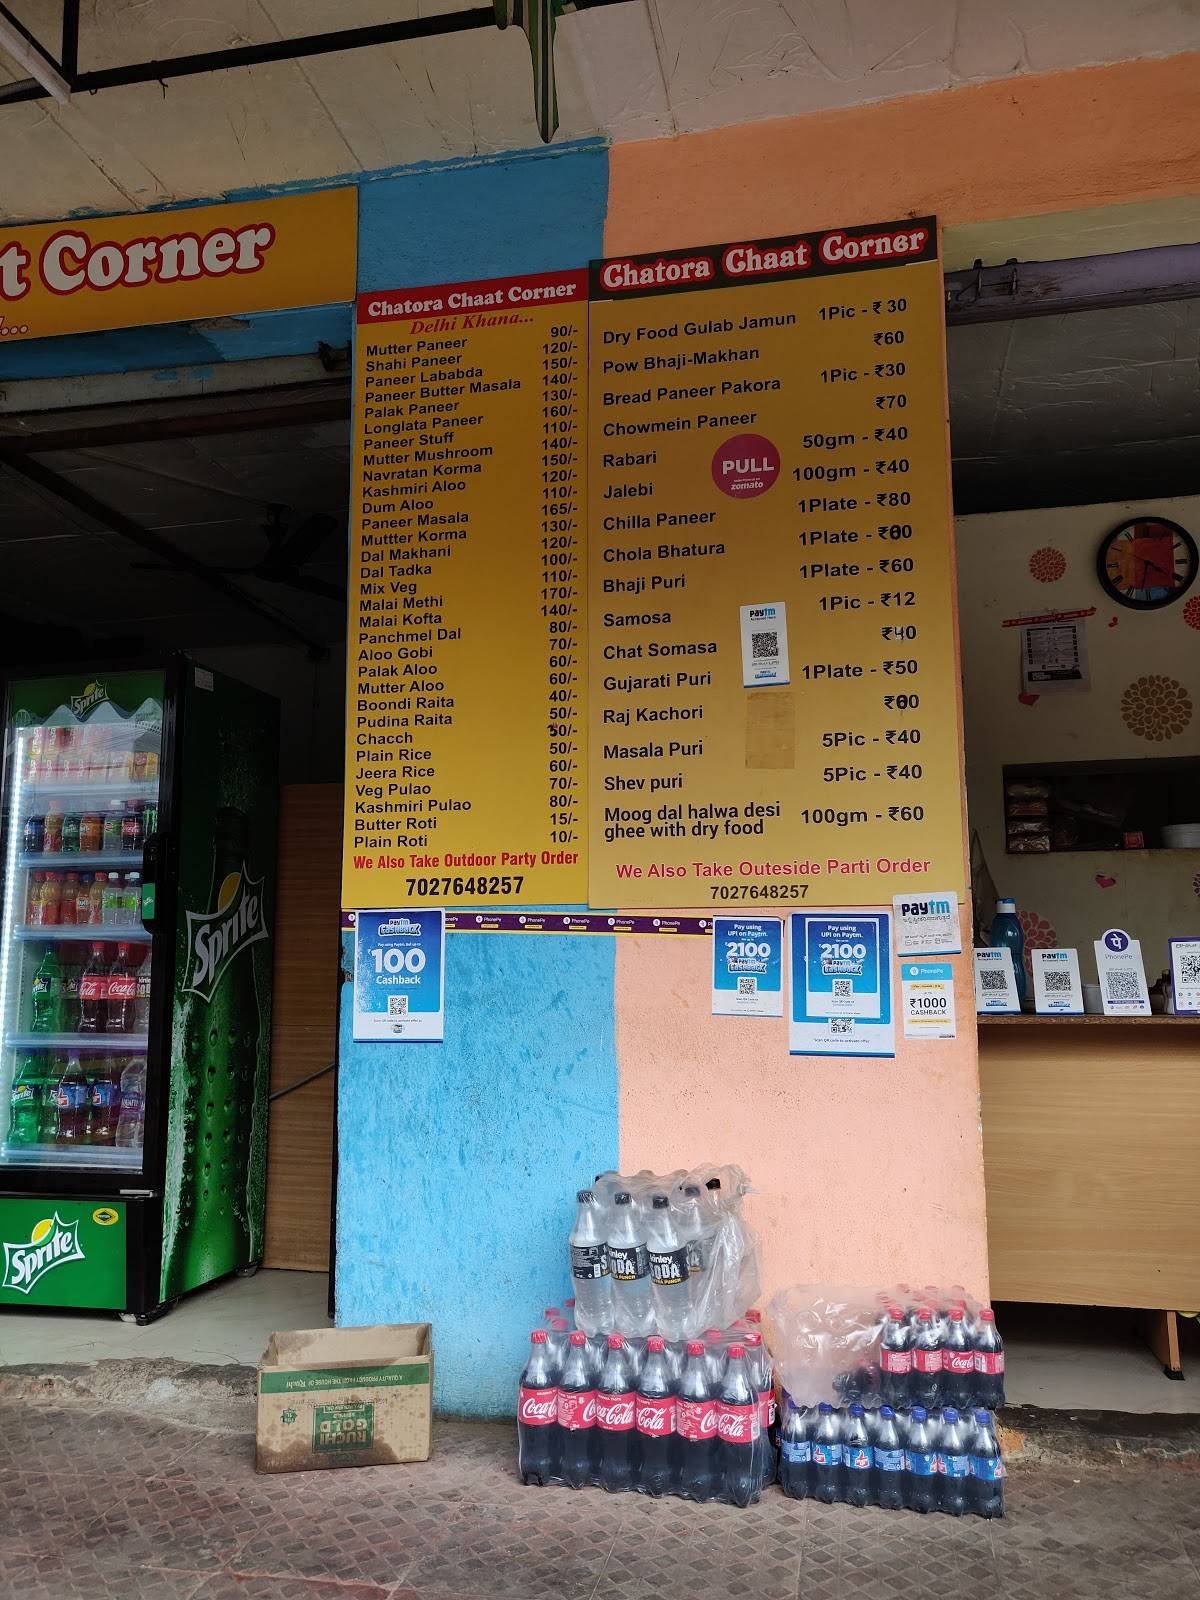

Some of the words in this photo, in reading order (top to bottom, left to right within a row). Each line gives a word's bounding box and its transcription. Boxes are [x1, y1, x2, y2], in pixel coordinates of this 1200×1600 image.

[41, 225, 273, 293] Corner
[603, 259, 710, 288] Chatora
[725, 245, 808, 273] Chaat
[823, 231, 925, 260] Corner
[368, 299, 443, 317] Chatora
[447, 290, 503, 309] Chaat
[507, 283, 577, 302] Corner
[818, 305, 856, 321] 1Pic
[872, 300, 882, 314] ₹
[886, 298, 907, 313] 30
[409, 317, 458, 334] Delhi
[461, 312, 534, 330] Khana...
[550, 324, 578, 338] 90/-
[603, 330, 631, 346] Dry
[636, 323, 678, 341] Food
[683, 318, 734, 336] Gulab
[738, 314, 796, 330] Jamun
[873, 330, 905, 346] ₹60
[366, 343, 413, 357] Mutter
[416, 338, 468, 352] Paneer
[541, 355, 578, 370] 150/-
[603, 360, 639, 374] Pow
[644, 348, 759, 370] Bhaji-Makhan
[365, 375, 416, 388] Paneer
[420, 366, 483, 383] Lababda
[542, 387, 578, 402] 130/-
[364, 405, 404, 419] Palak
[408, 401, 460, 415] Paneer
[542, 419, 578, 434] 110/-
[363, 437, 415, 450] Paneer
[418, 431, 455, 446] Stuff
[802, 433, 854, 450] 50gm
[873, 426, 908, 442] ₹40
[541, 452, 578, 467] 150/-
[603, 450, 657, 468] Rabari
[722, 457, 775, 475] PULL
[362, 467, 428, 482] Navratan
[432, 463, 482, 476] Korma
[792, 465, 856, 482] 100gm
[875, 458, 910, 475] ₹40
[542, 484, 578, 500] 110/-
[603, 481, 653, 499] Jalebi
[730, 481, 764, 490] zomato
[362, 502, 396, 514] Dum
[399, 498, 434, 511] Aloo
[797, 497, 858, 513] 1Plate
[876, 491, 911, 507] ₹80
[541, 518, 578, 533] 130/-
[603, 514, 651, 531] Chilla
[656, 511, 717, 527] Paneer
[361, 533, 414, 546] Muttter
[418, 529, 467, 542] Korma
[541, 552, 578, 566] 100/-
[360, 565, 384, 579] Dal
[387, 563, 432, 577] Tadka
[540, 585, 578, 600] 170/-
[818, 595, 861, 611] 1Pic
[880, 591, 916, 607] ₹12
[359, 598, 398, 612] Malai
[402, 595, 443, 609] Methi
[549, 619, 578, 634] 80/-
[603, 612, 671, 627] Samosa
[358, 628, 432, 644] Panchmel
[437, 627, 461, 641] Dal
[549, 654, 578, 668] 60/-
[802, 663, 863, 680] 1Plate
[882, 659, 918, 675] ₹50
[358, 664, 399, 678] Palak
[402, 663, 437, 676] Aloo
[603, 672, 670, 693] Gujarati
[676, 671, 711, 687] Puri
[74, 686, 104, 715] Sprite
[548, 688, 578, 702] 40/-
[357, 697, 411, 712] Boondi
[416, 696, 454, 709] Raita
[822, 731, 866, 747] 5Pic
[884, 728, 921, 745] ₹40
[356, 749, 393, 762] Plain
[398, 747, 432, 761] Rice
[549, 740, 578, 755] 50/-
[603, 741, 664, 759] Masala
[669, 739, 703, 757] Puri
[355, 784, 383, 799] Veg
[388, 782, 431, 796] Pulao
[549, 776, 578, 790] 70/-
[550, 811, 578, 825] 15/-
[604, 807, 652, 824] Moog
[657, 803, 682, 820] dal
[688, 803, 739, 819] halwa
[743, 801, 780, 818] desi
[801, 808, 868, 827] 100gm
[887, 805, 924, 821] ₹60
[354, 818, 402, 831] Butter
[406, 816, 437, 830] Roti
[604, 822, 645, 843] ghee
[650, 820, 686, 838] with
[691, 820, 719, 840] dry
[723, 818, 764, 835] food
[354, 835, 392, 848] Plain
[397, 834, 428, 847] Roti
[549, 829, 578, 843] 10/-
[353, 855, 373, 869] We
[377, 854, 405, 869] Also
[409, 854, 440, 868] Take
[444, 853, 497, 867] Outdoor
[501, 852, 537, 868] Party
[541, 850, 579, 865] Order
[615, 863, 642, 878] We
[647, 863, 687, 878] Also
[692, 862, 733, 877] Take
[738, 860, 821, 876] Outeside
[826, 859, 871, 874] Parti
[876, 857, 931, 873] Order
[405, 876, 524, 896] 7027648257
[710, 885, 809, 899] 7027648257
[192, 882, 258, 987] Sprite
[376, 975, 421, 985] Cashback
[910, 998, 947, 1008] ₹1000
[12, 1225, 75, 1284] Sprite
[320, 1419, 368, 1432] GOLD
[320, 1431, 367, 1445] RUCHI
